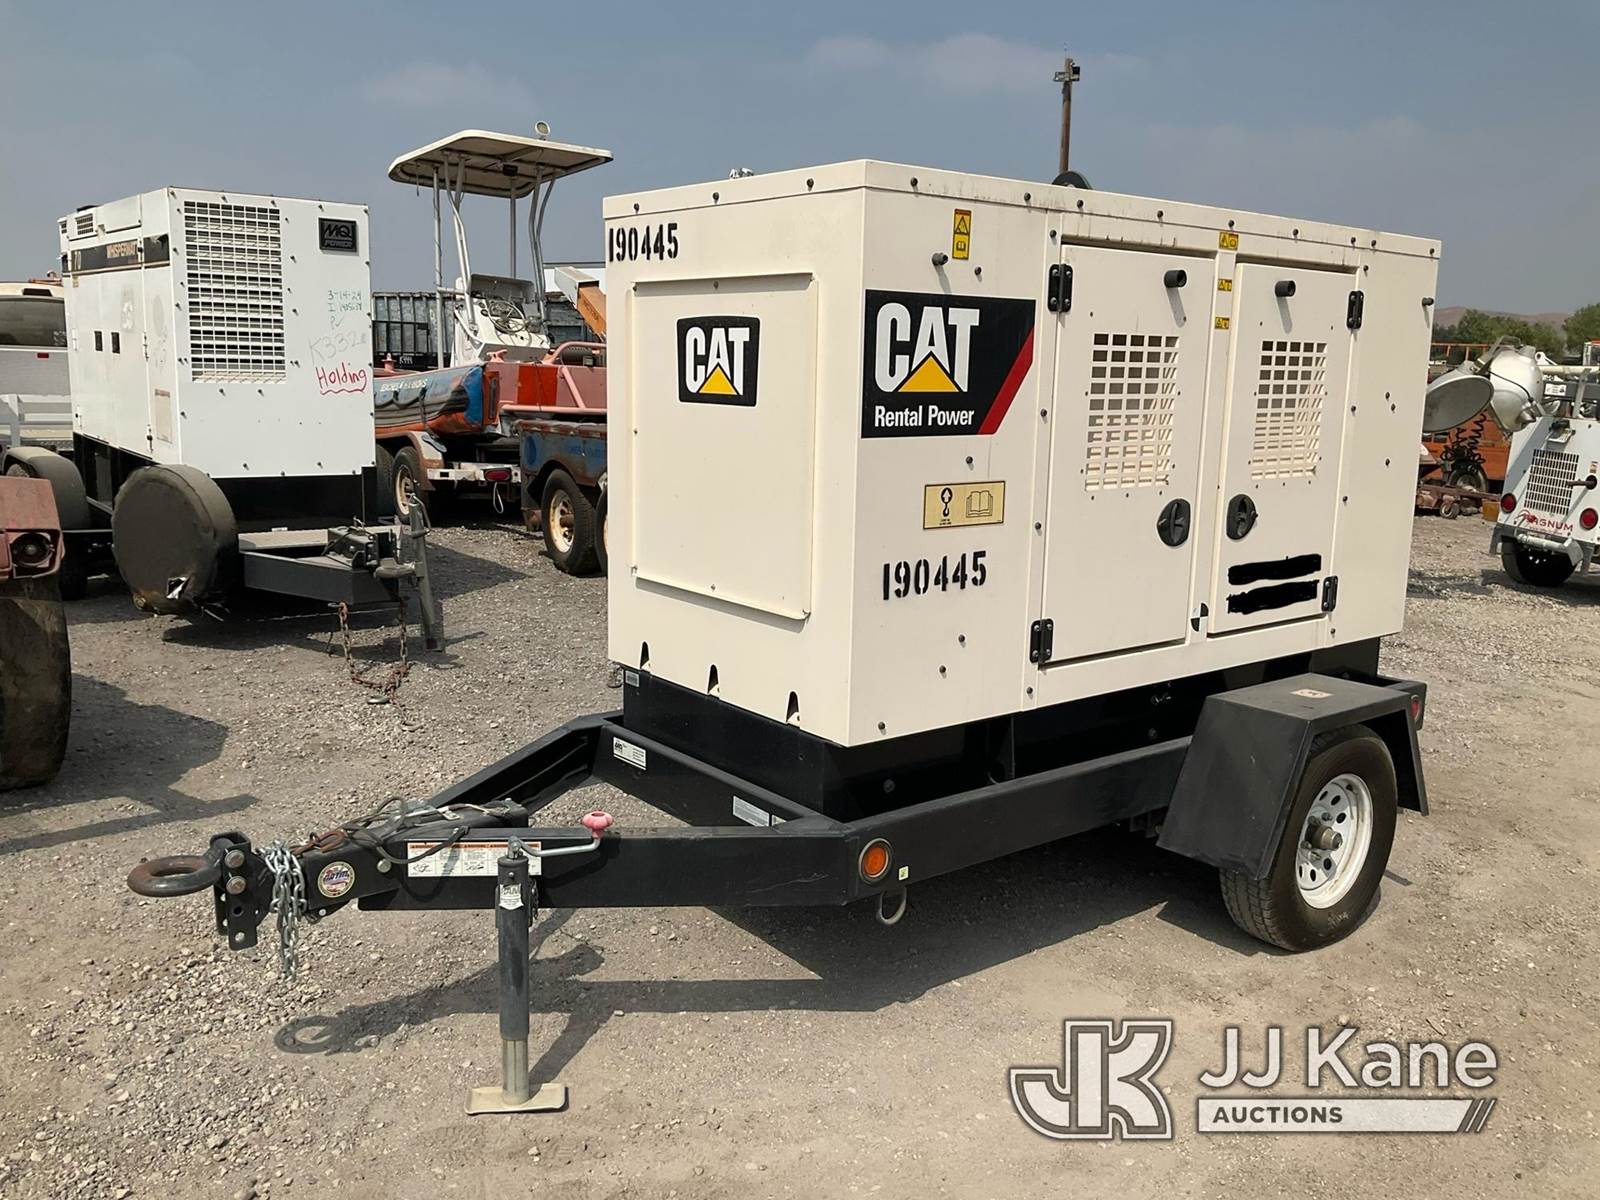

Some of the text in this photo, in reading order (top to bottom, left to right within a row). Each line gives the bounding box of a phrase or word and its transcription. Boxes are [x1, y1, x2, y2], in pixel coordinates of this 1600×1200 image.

[322, 223, 353, 239] MQ
[609, 222, 679, 263] 190445
[685, 326, 750, 396] CAT
[876, 302, 980, 393] CAT
[315, 361, 367, 393] Holding
[874, 405, 975, 427] Rental Power
[883, 550, 987, 601] 190445
